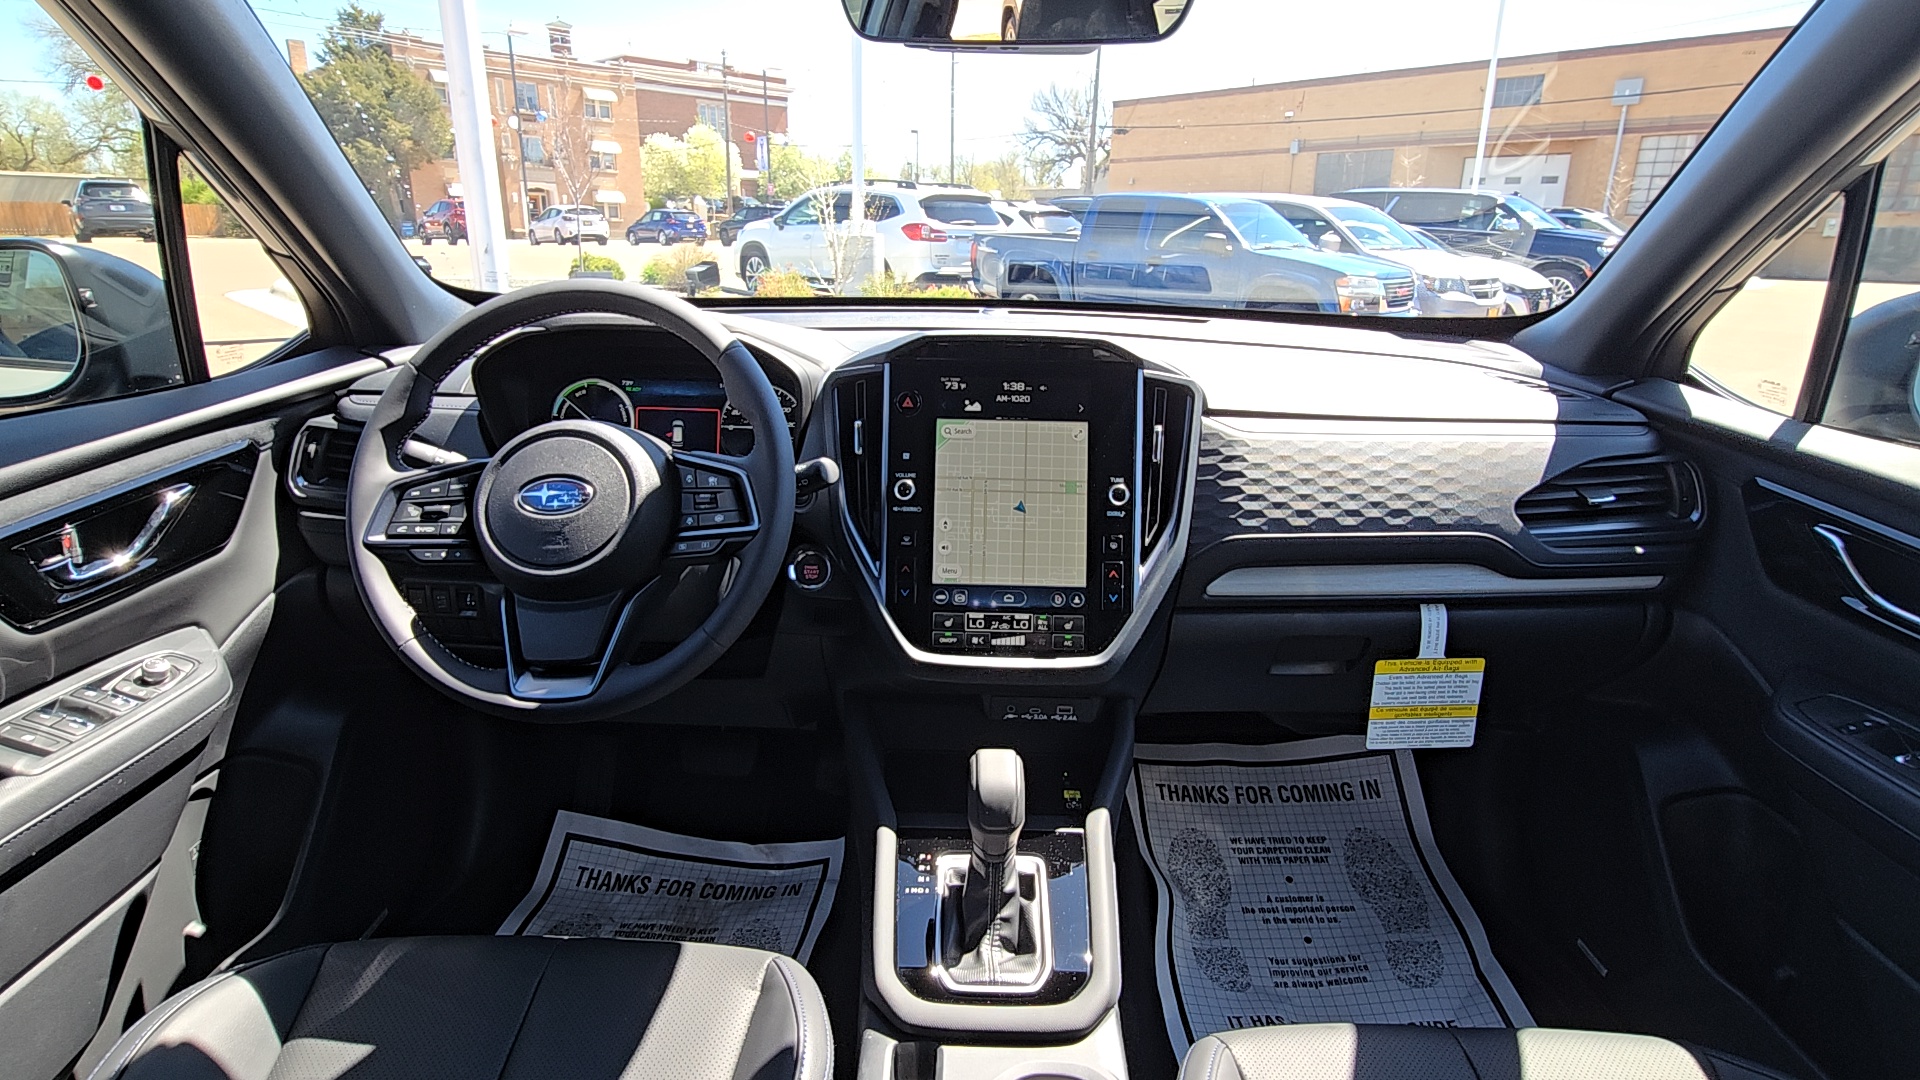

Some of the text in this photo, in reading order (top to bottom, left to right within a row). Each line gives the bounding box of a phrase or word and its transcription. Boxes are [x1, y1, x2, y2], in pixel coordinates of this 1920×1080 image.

[1003, 382, 1025, 391] 1:38
[969, 620, 985, 628] LO
[1013, 620, 1029, 629] LO
[1155, 778, 1382, 804] THANKS FOR COMING IN
[1306, 836, 1327, 844] KEEP
[575, 865, 803, 900] THANKS FOR COMING IN
[1241, 905, 1356, 914] the most important person
[1272, 916, 1287, 924] the
[1289, 916, 1312, 924] world
[614, 930, 639, 938] YOUR
[658, 924, 683, 933] TRIED
[686, 927, 696, 935] TO
[1268, 957, 1289, 965] Your
[1291, 956, 1346, 966] suggestions
[1269, 963, 1369, 978] improving our service
[1292, 980, 1324, 989] always
[1326, 976, 1372, 987] welcome.
[1226, 1014, 1287, 1029] IT HAS
